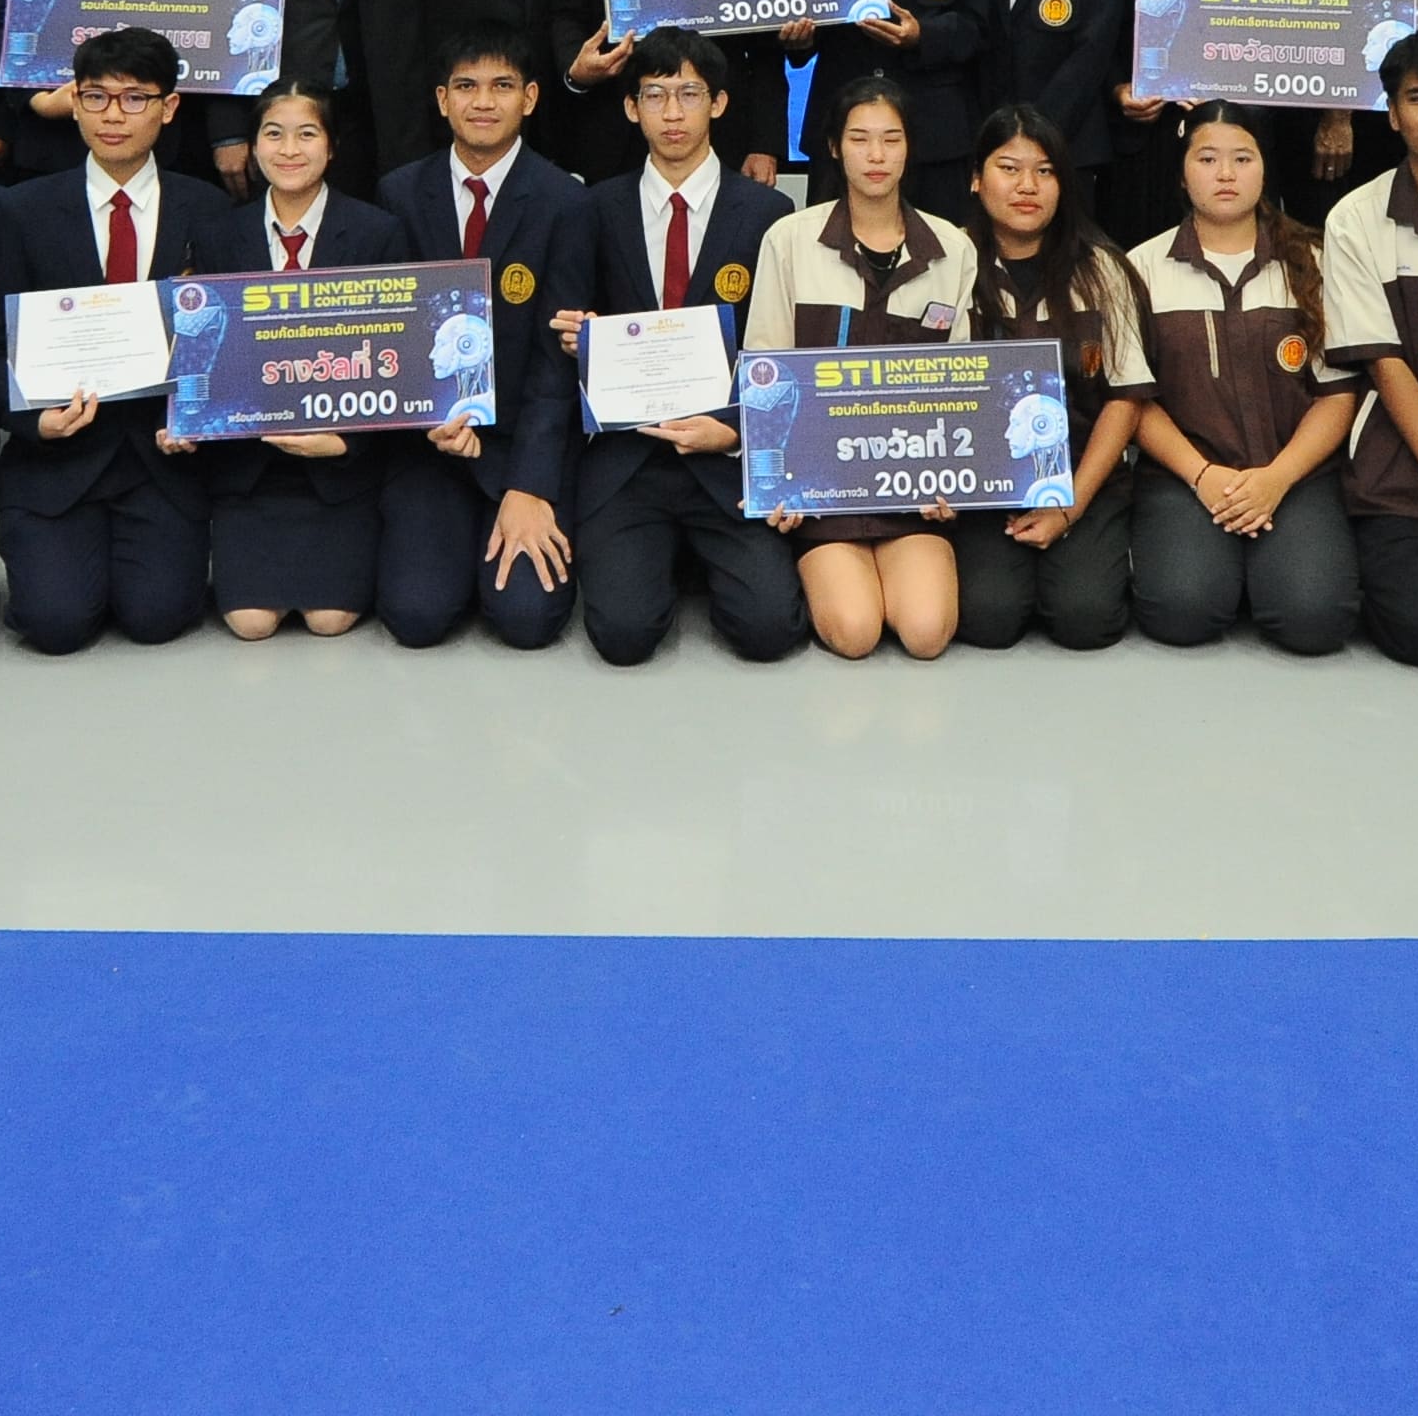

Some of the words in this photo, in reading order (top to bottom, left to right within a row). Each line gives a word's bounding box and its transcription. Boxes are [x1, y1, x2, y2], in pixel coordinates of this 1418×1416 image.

[813, 1, 839, 14] บาท
[194, 70, 220, 81] บาท
[1253, 73, 1325, 97] 5,000
[1331, 85, 1357, 97] บาท
[242, 283, 309, 311] STI
[313, 277, 417, 295] INVENTIONS
[314, 294, 374, 307] CONTEST
[377, 349, 399, 378] 3
[815, 360, 881, 388] STI
[886, 356, 989, 372] INVENTIONS
[886, 371, 946, 384] CONTEST
[301, 390, 397, 422] 10,000
[404, 400, 433, 413] บาท
[952, 427, 974, 457] 2
[875, 469, 977, 500] 20,000
[984, 480, 1013, 493] บาท
